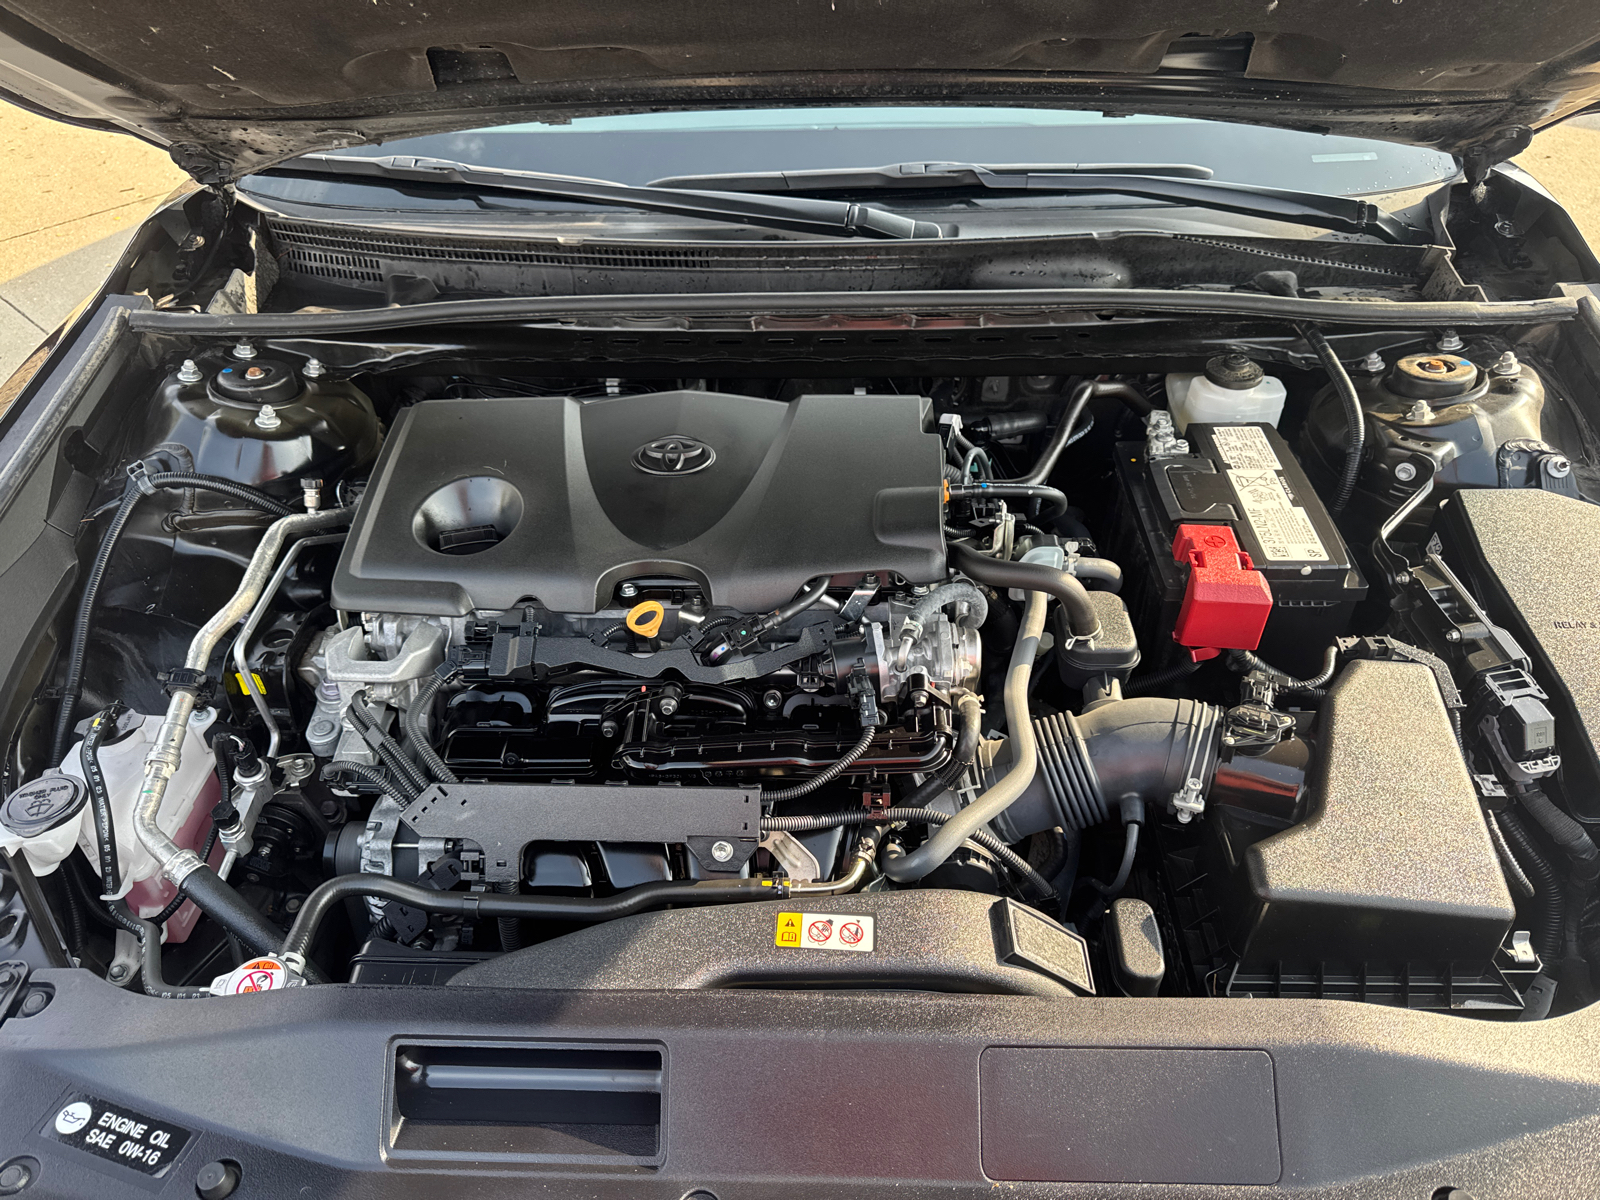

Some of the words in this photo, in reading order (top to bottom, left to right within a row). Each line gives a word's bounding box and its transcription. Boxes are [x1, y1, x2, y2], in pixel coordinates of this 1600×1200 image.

[1307, 548, 1322, 558] SP
[1553, 621, 1587, 629] RELAY
[1589, 621, 1598, 629] &
[97, 1112, 149, 1139] ENGINE
[149, 1130, 171, 1148] OIL
[85, 1128, 117, 1149] SAE
[118, 1140, 162, 1166] 0W-16
